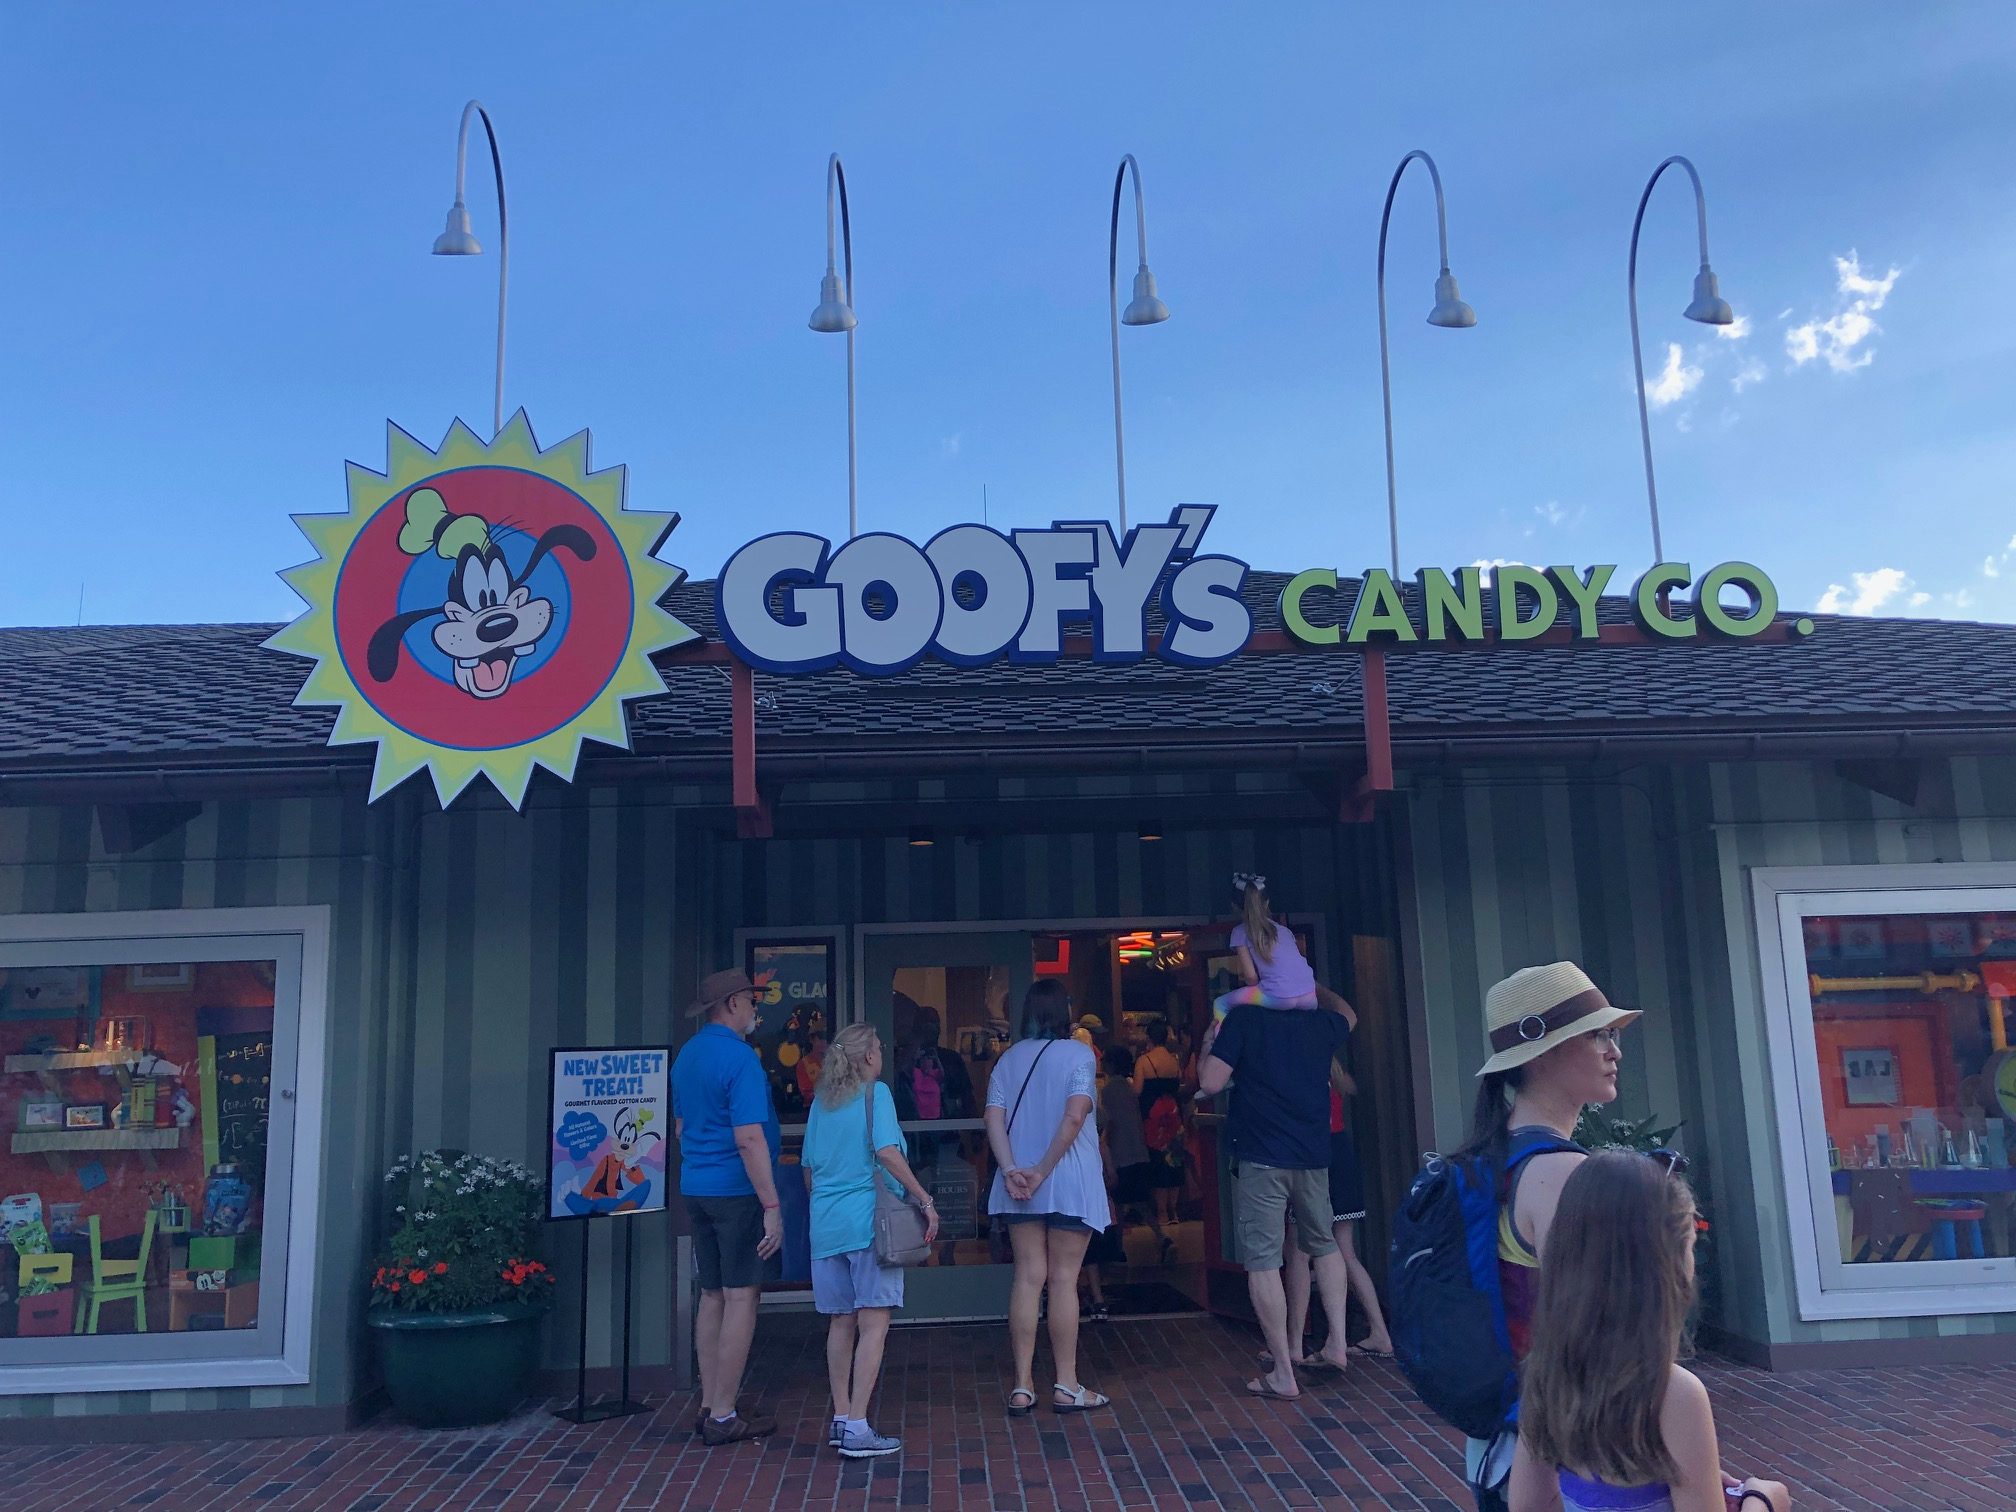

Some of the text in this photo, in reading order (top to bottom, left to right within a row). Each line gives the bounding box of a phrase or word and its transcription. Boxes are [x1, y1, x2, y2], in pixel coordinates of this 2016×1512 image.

[1277, 564, 1617, 645] CANDY
[1630, 561, 1815, 638] CO.
[563, 1053, 663, 1076] NEW SWEET
[582, 1076, 643, 1097] TREAT!
[564, 1096, 657, 1107] GOURMET FLAVORED COTTON CANDY
[936, 1185, 968, 1195] HOURS
